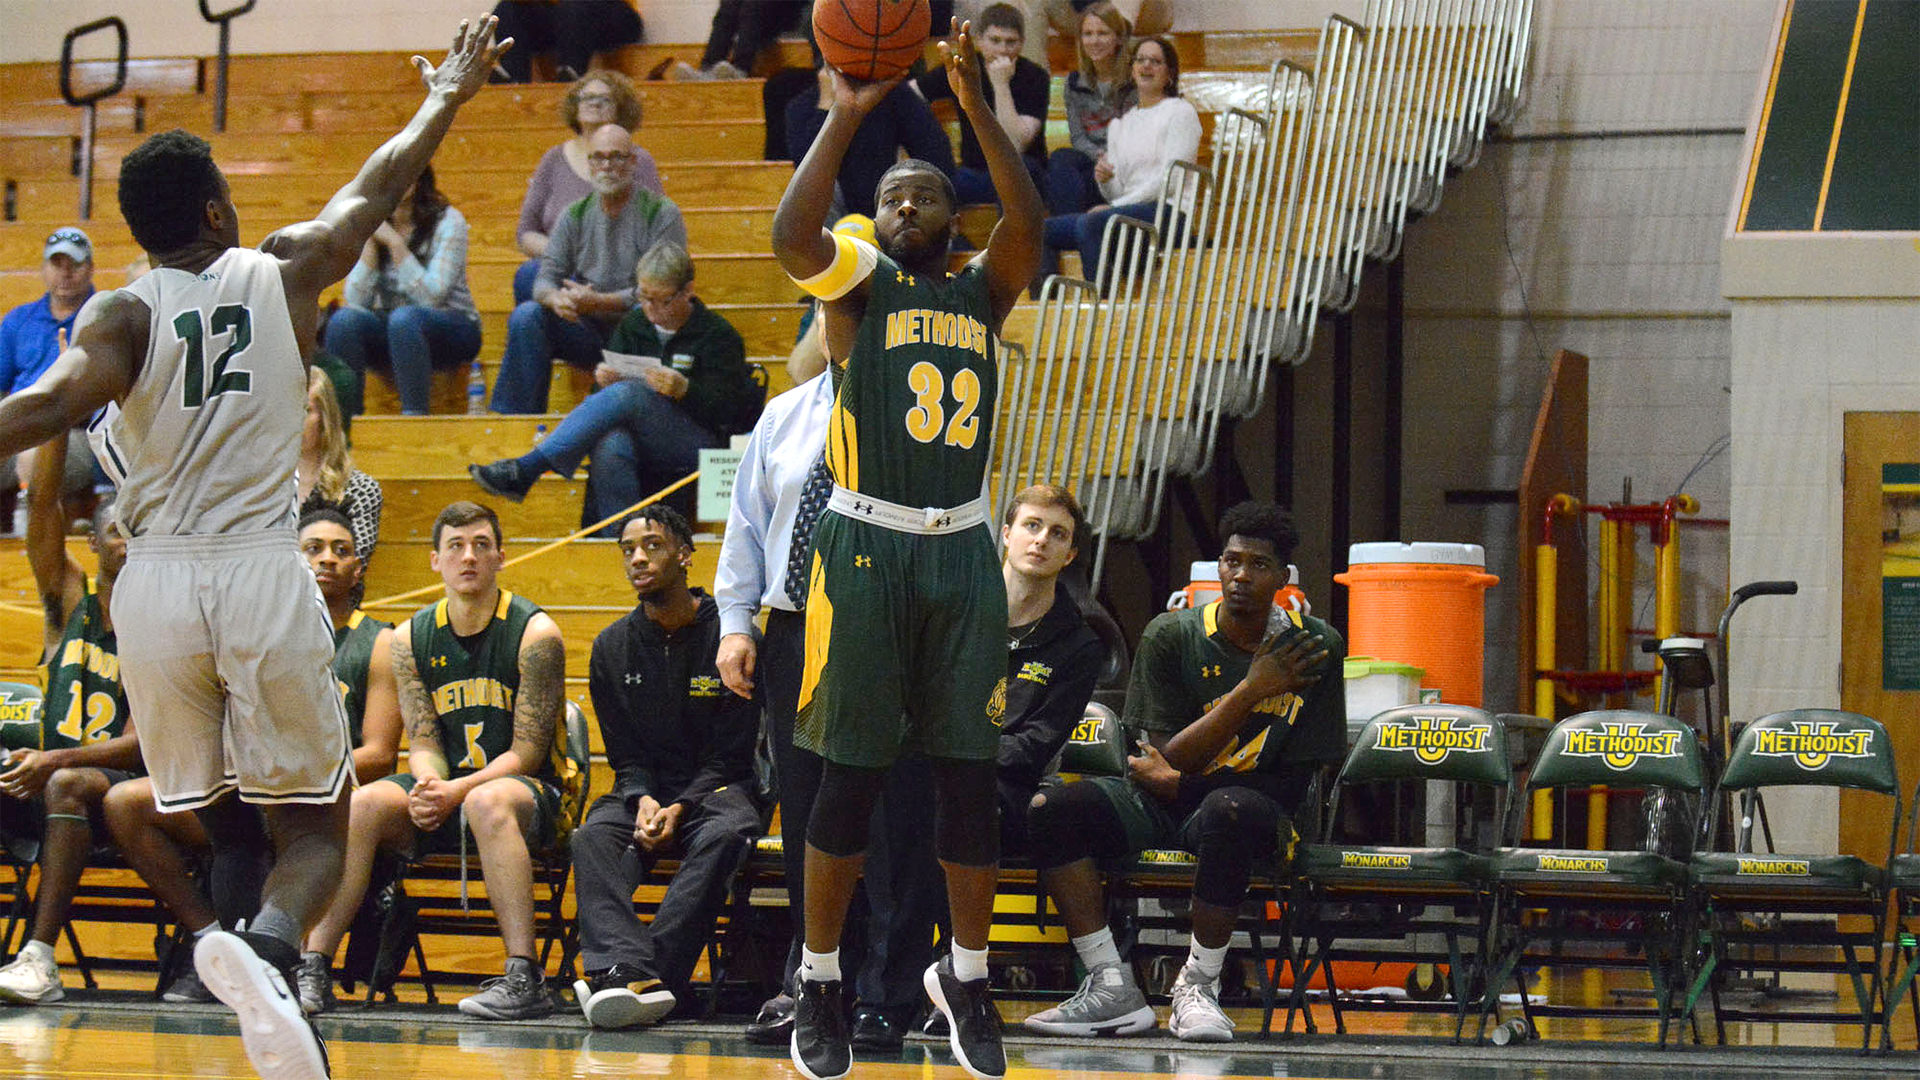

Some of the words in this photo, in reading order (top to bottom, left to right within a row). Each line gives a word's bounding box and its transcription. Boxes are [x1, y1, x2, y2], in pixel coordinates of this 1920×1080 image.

[172, 303, 252, 411] 12
[905, 361, 981, 449] 32
[56, 680, 118, 747] 12
[458, 721, 487, 768] 5
[1380, 725, 1488, 750] METHODIST
[1568, 731, 1679, 754] METHODIST
[1759, 730, 1870, 754] METHODIST
[1344, 854, 1409, 868] MONARCHS
[1541, 857, 1606, 871] MONARCHS
[1740, 860, 1808, 874] MONARCHS
